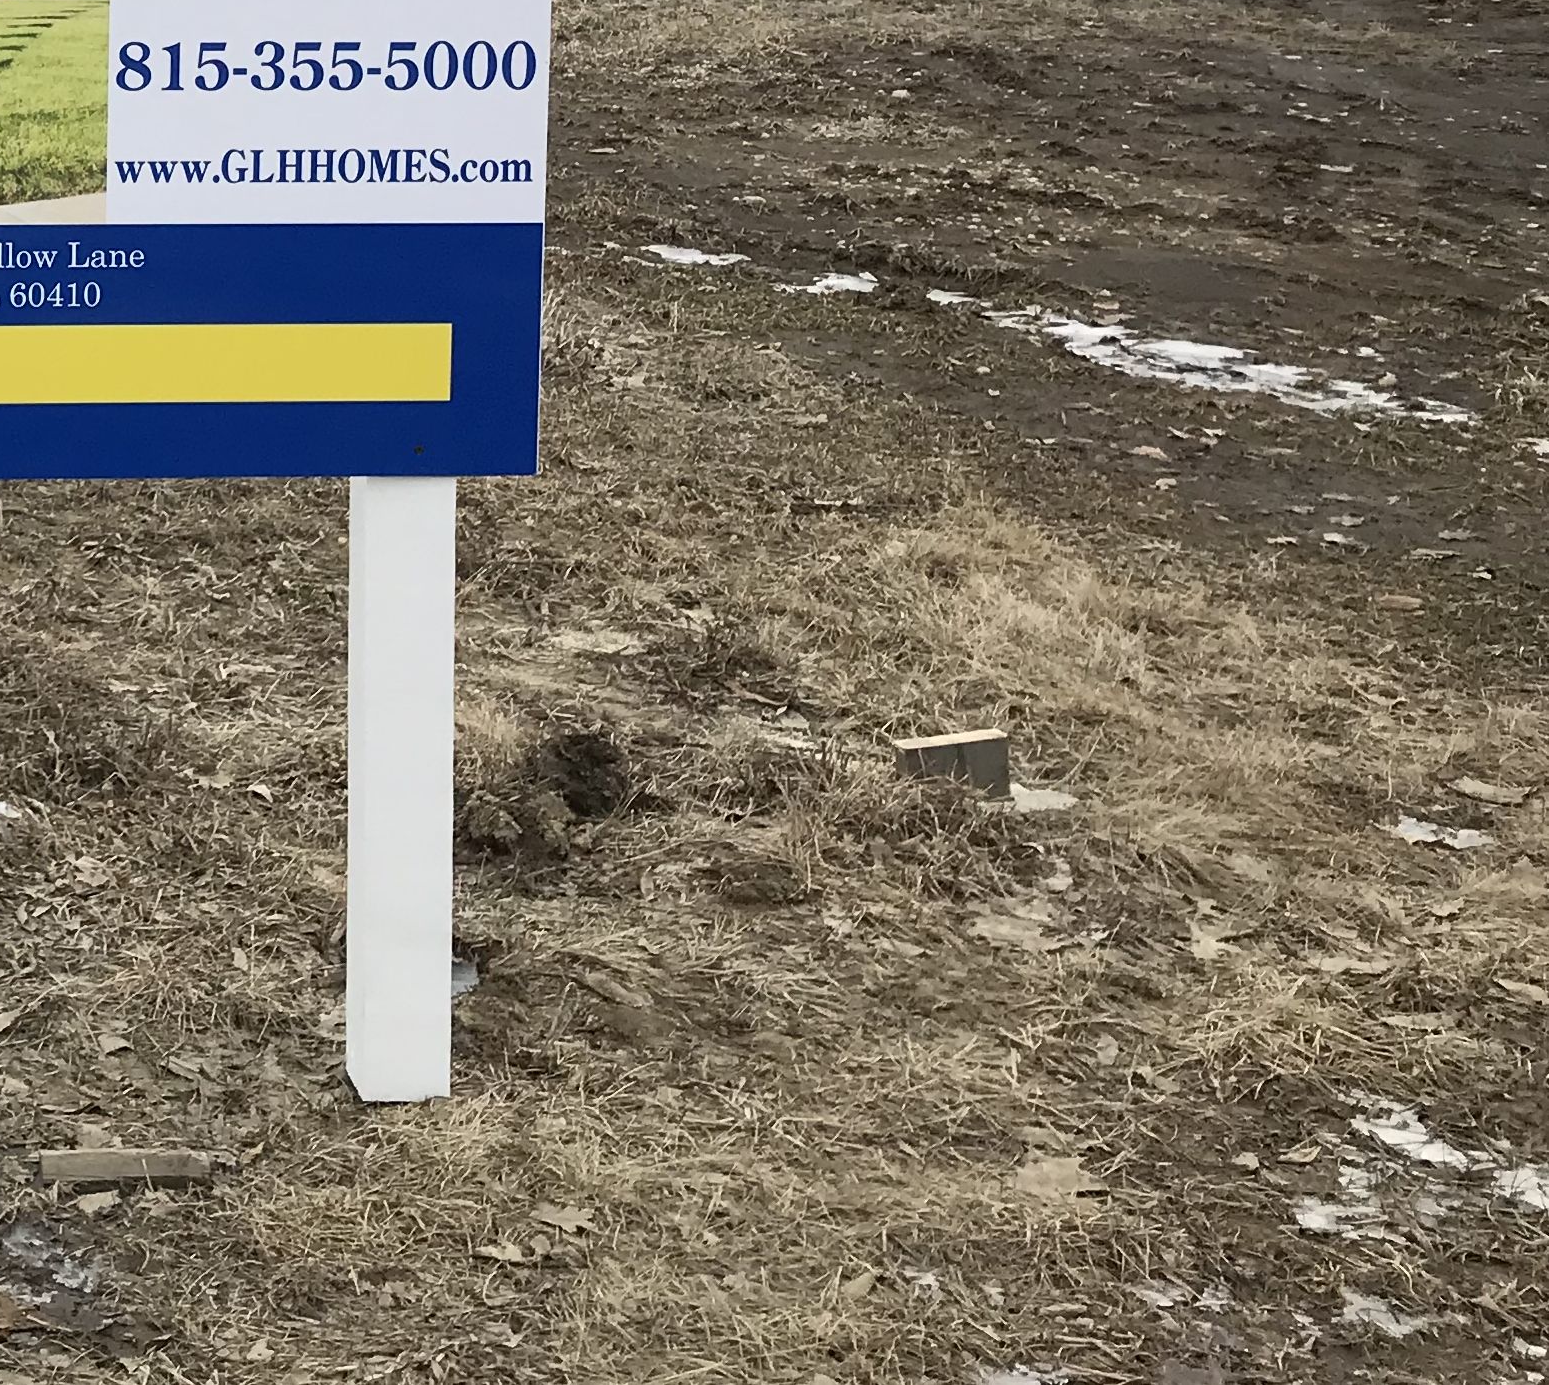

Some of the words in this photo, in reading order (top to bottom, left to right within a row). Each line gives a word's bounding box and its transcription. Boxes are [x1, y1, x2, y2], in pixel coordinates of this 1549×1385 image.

[114, 40, 537, 92] 815-355-5000
[114, 147, 534, 186] www.GLHHOMES.com
[68, 241, 146, 268] Lane
[9, 281, 102, 307] 60410
